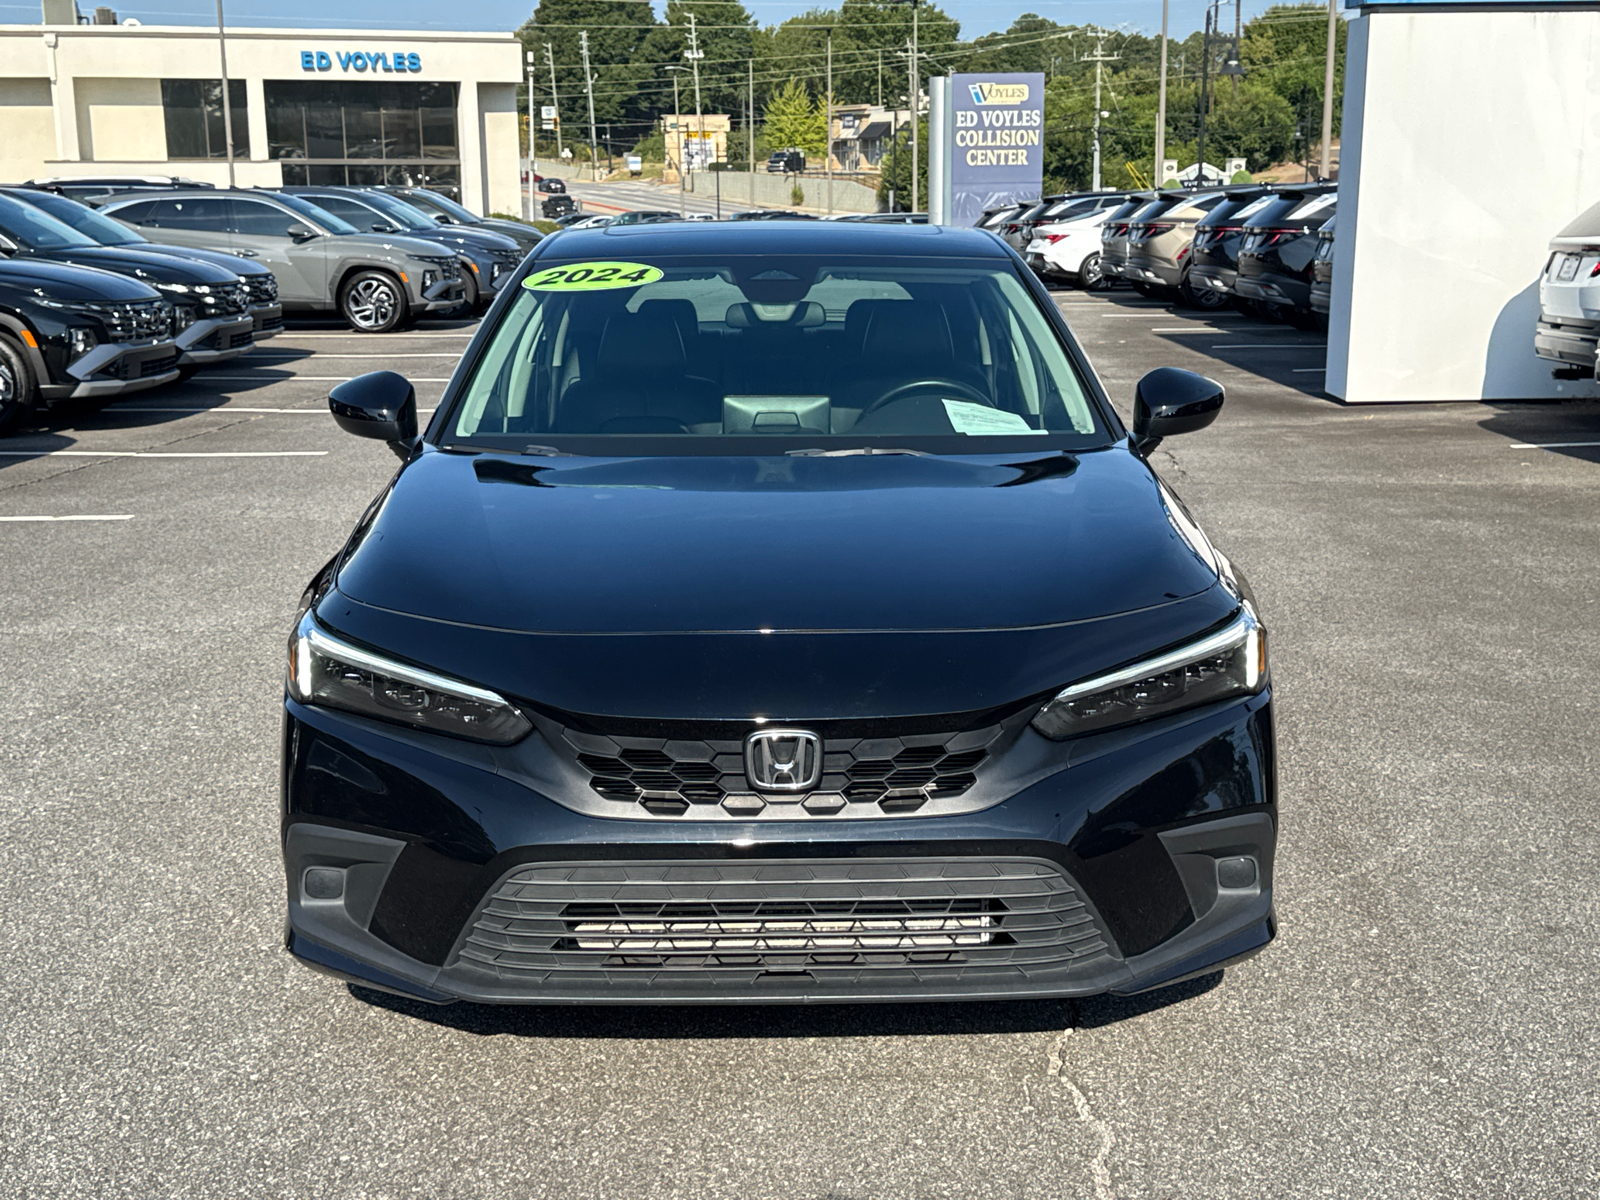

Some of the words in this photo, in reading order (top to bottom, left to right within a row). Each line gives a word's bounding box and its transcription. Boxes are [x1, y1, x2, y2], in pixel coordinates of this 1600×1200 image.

[300, 50, 332, 72] ED
[335, 51, 422, 73] VOYLES
[956, 110, 978, 127] ED
[981, 110, 1041, 127] VOYLES
[956, 129, 1040, 147] COLLISION
[966, 149, 1028, 166] CENTER
[533, 268, 651, 286] 2024
